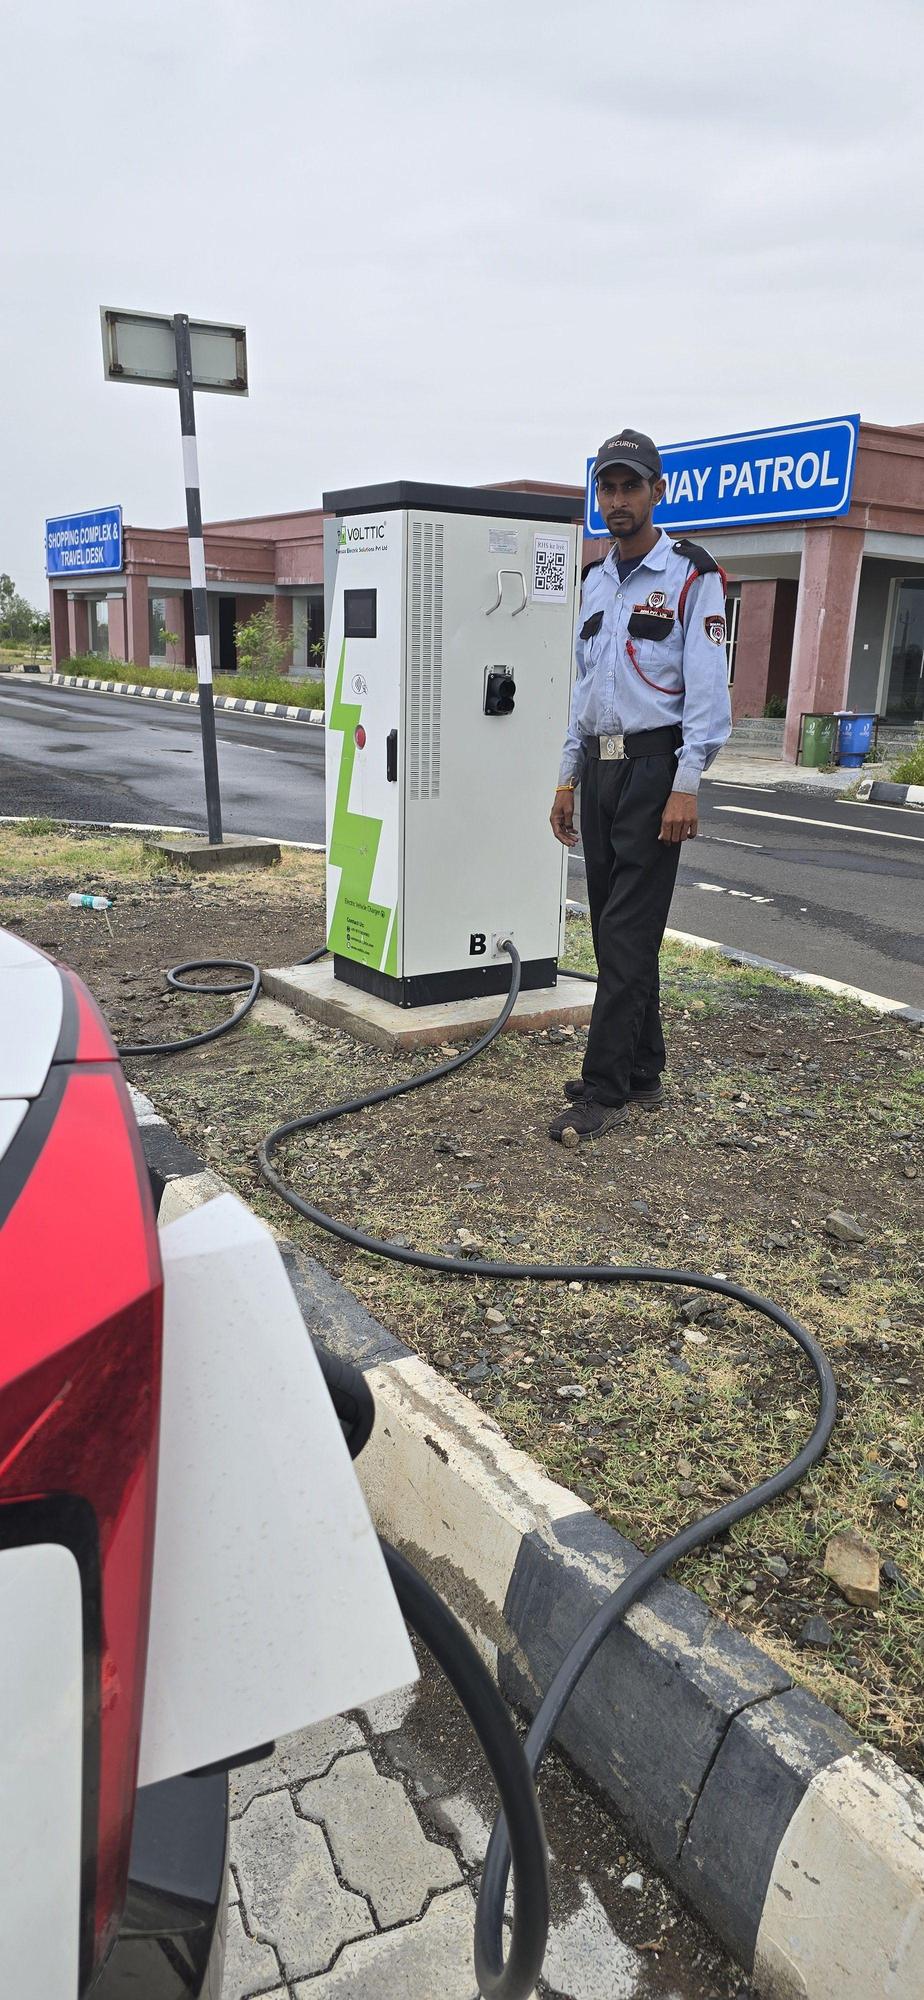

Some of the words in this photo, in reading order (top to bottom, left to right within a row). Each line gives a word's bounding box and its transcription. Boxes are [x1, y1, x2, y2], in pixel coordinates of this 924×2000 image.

[607, 440, 639, 450] SECURITY
[718, 450, 839, 499] PATROL
[48, 529, 79, 549] SHOPPING
[80, 523, 112, 545] COMPLEX
[112, 522, 119, 540] &
[347, 525, 385, 541] VOLTTIC
[61, 549, 85, 567] TRAVEL
[86, 546, 104, 565] DESK
[469, 933, 487, 956] B
